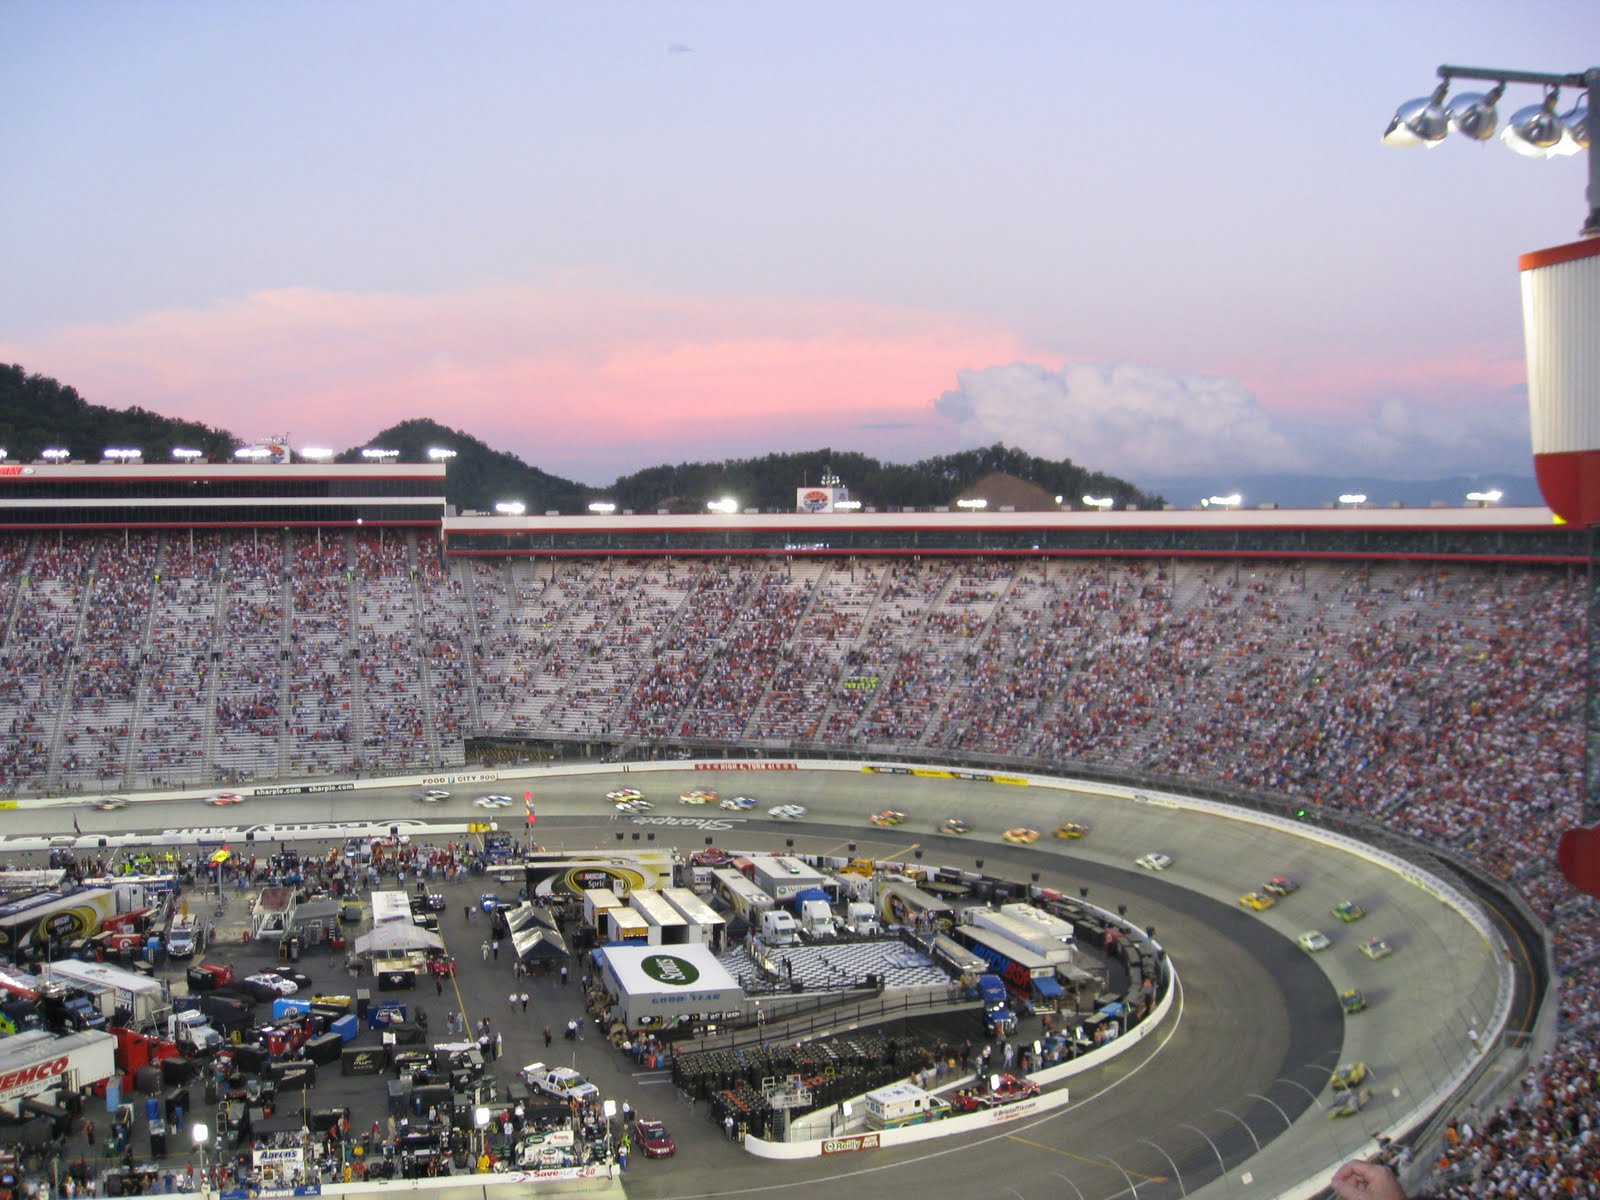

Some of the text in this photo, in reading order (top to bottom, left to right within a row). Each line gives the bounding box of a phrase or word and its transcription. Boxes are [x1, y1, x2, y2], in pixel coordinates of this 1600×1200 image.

[256, 784, 353, 796] sharpie.com sharpie.com
[0, 1055, 70, 1091] EMCO
